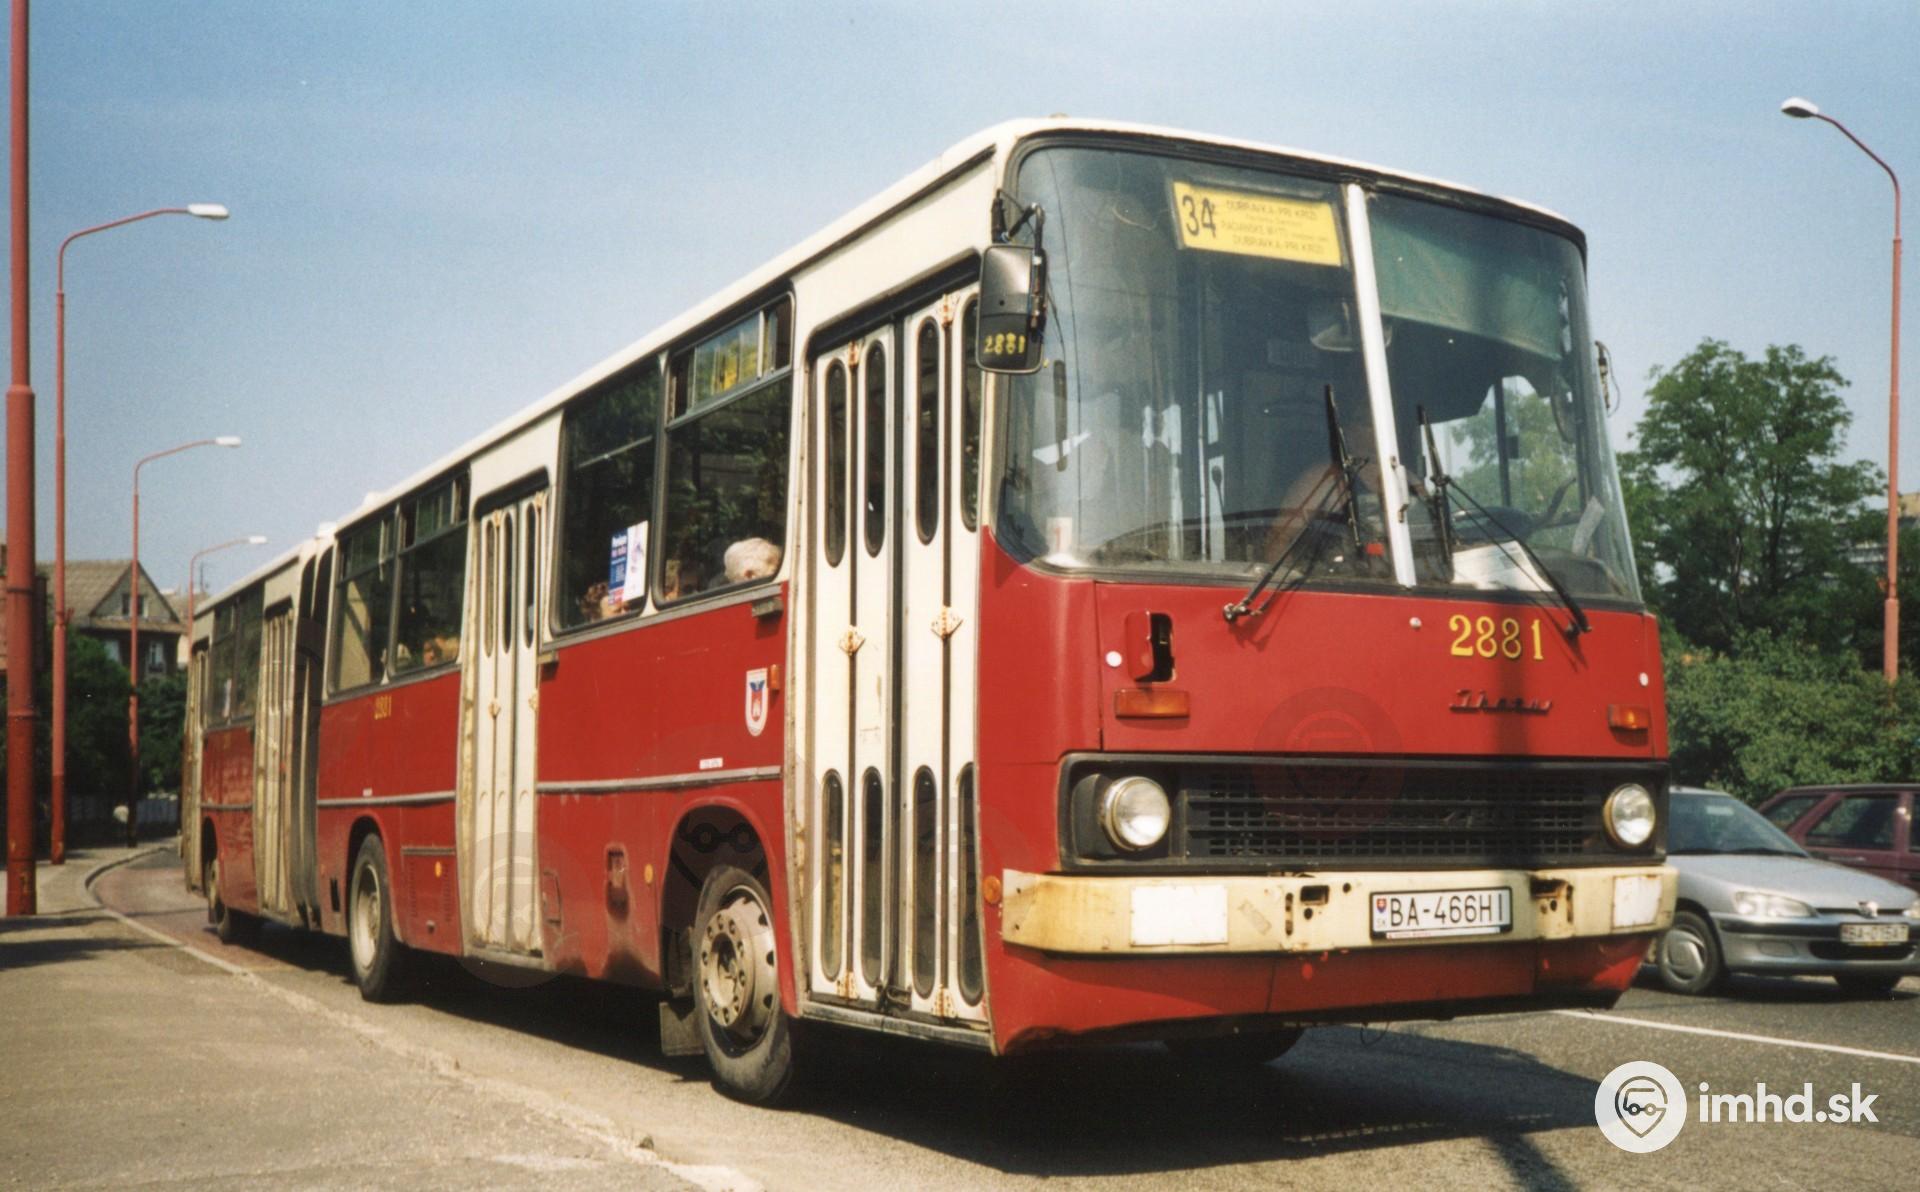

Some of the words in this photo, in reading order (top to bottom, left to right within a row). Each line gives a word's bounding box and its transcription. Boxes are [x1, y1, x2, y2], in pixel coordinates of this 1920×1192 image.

[1181, 194, 1216, 239] 34
[983, 331, 1026, 355] 2881
[1449, 614, 1544, 660] 2881
[1389, 893, 1503, 927] BA-466HI
